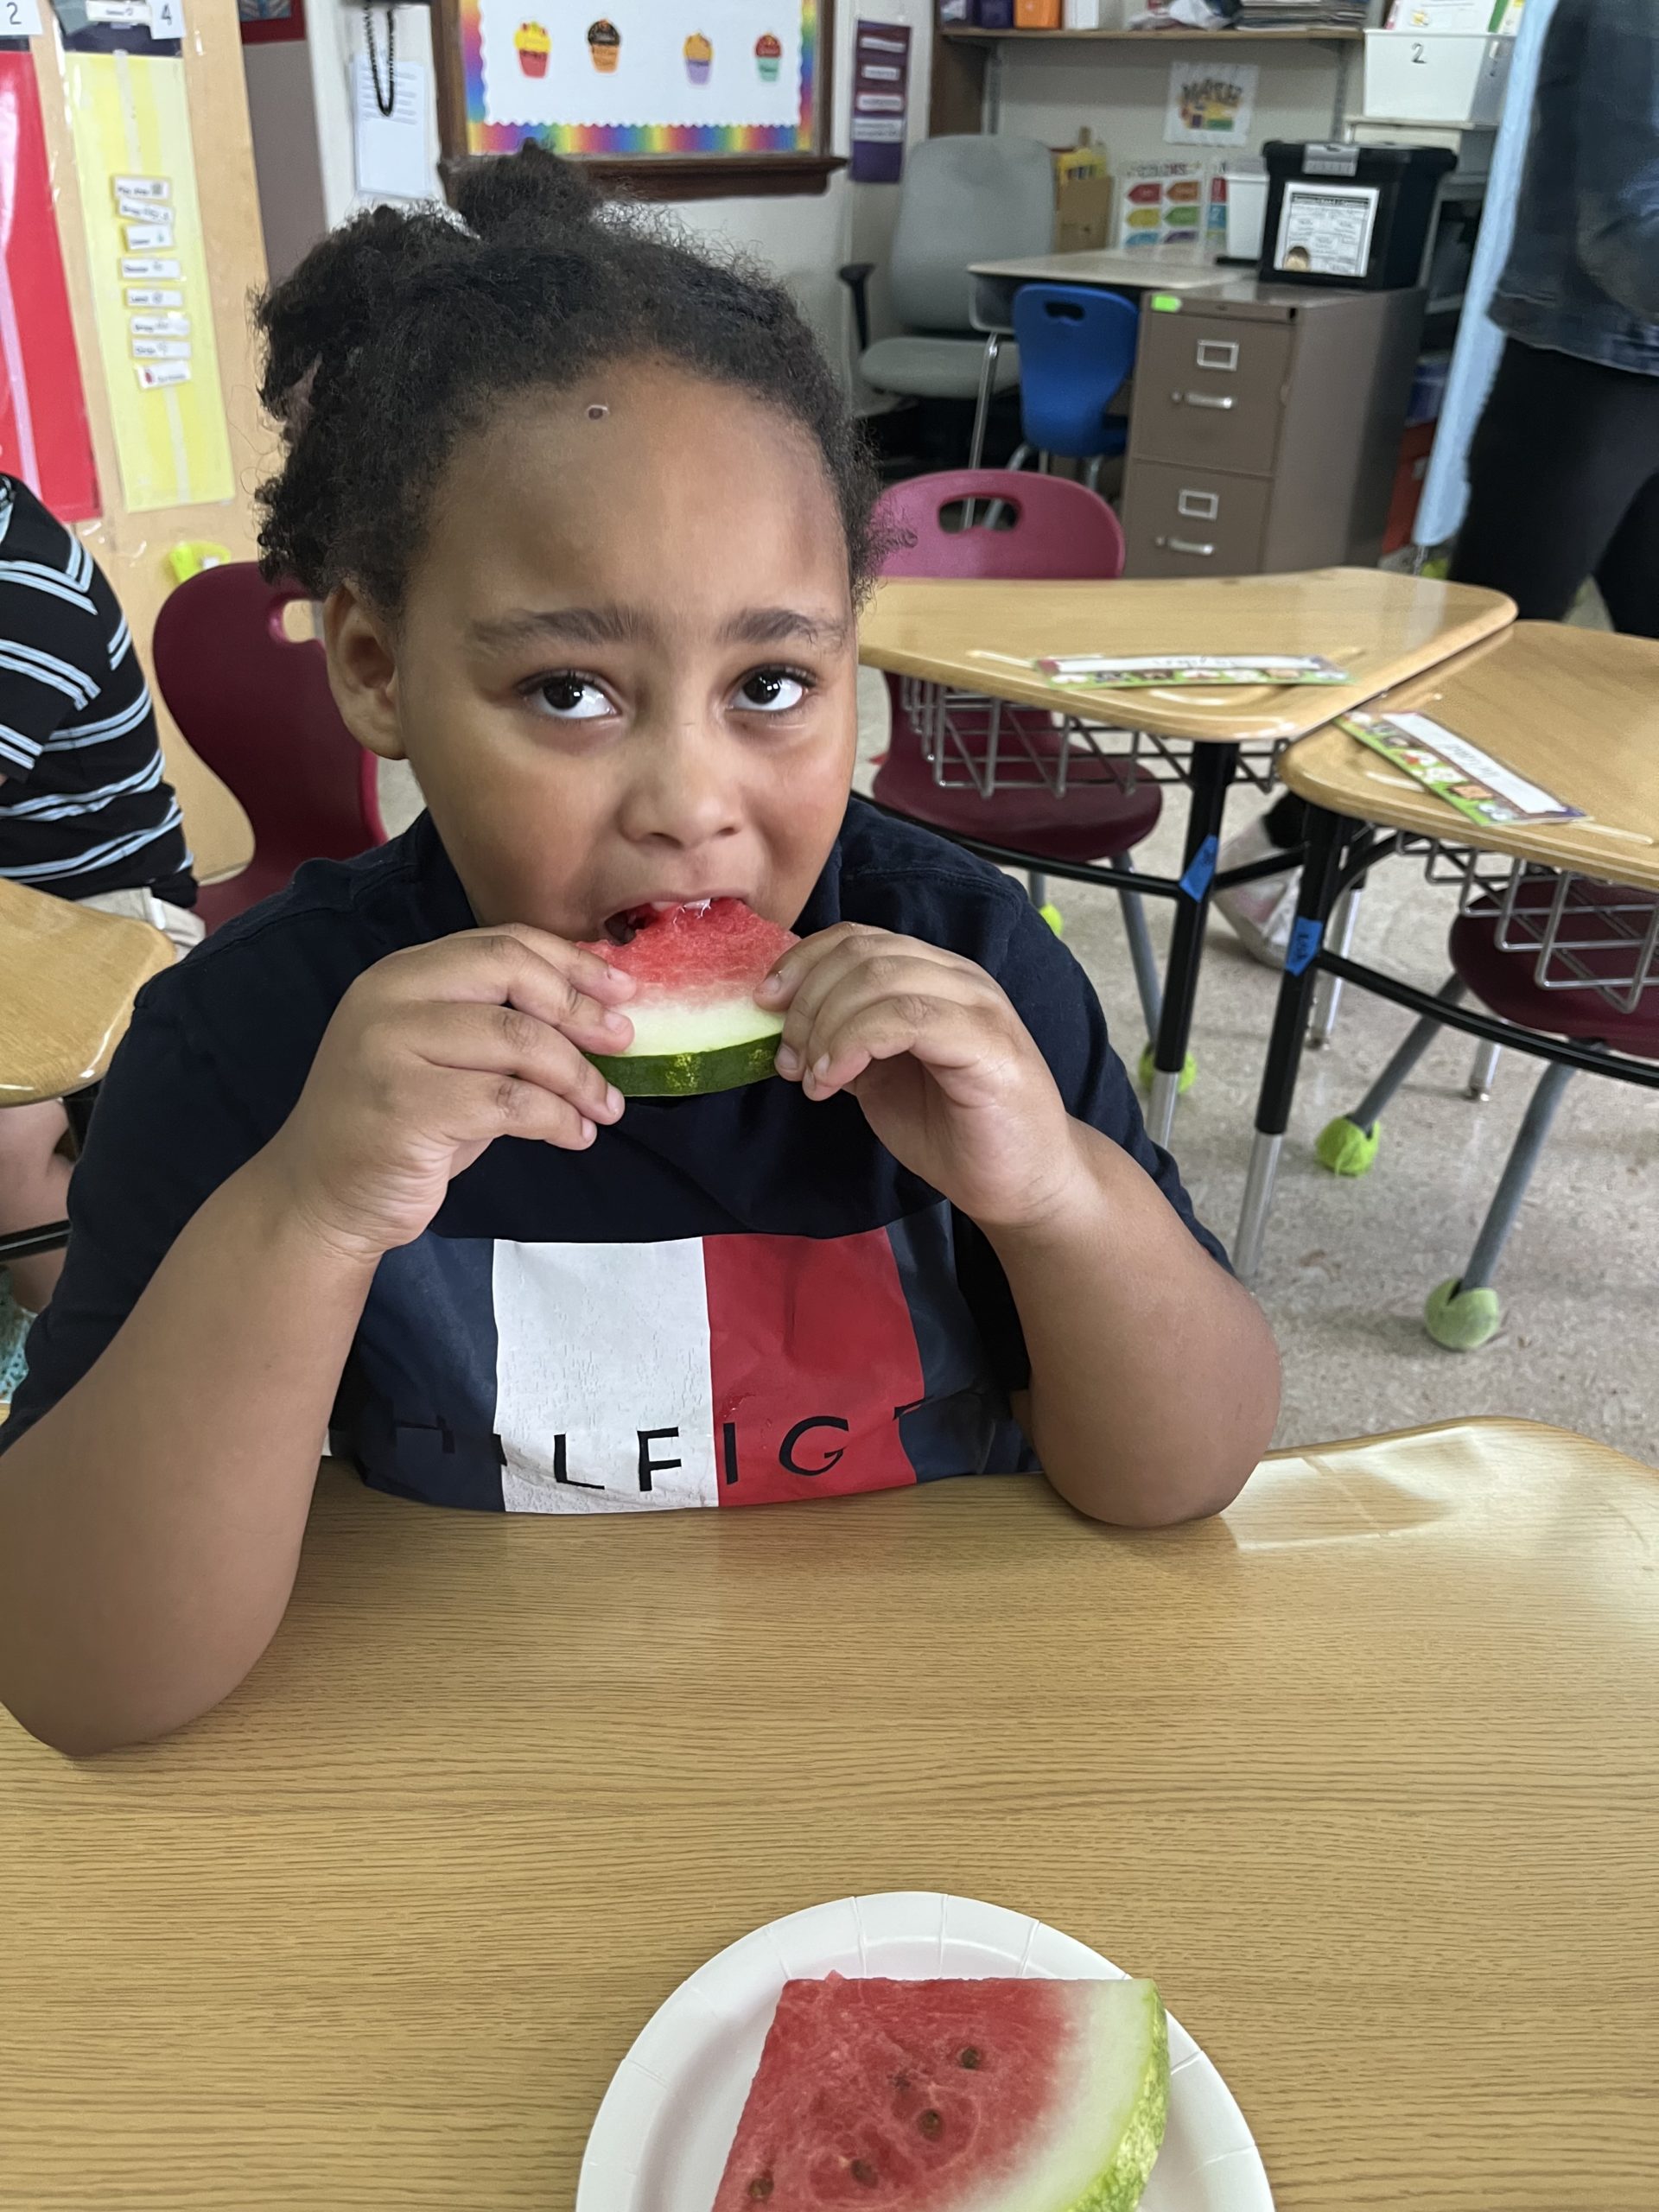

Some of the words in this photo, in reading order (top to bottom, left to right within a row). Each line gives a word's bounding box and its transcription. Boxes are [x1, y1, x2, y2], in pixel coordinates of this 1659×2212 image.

[6, 2, 22, 25] 2
[161, 3, 173, 26] 4
[1411, 42, 1427, 64] 2
[387, 1395, 926, 1492] HILFIG
